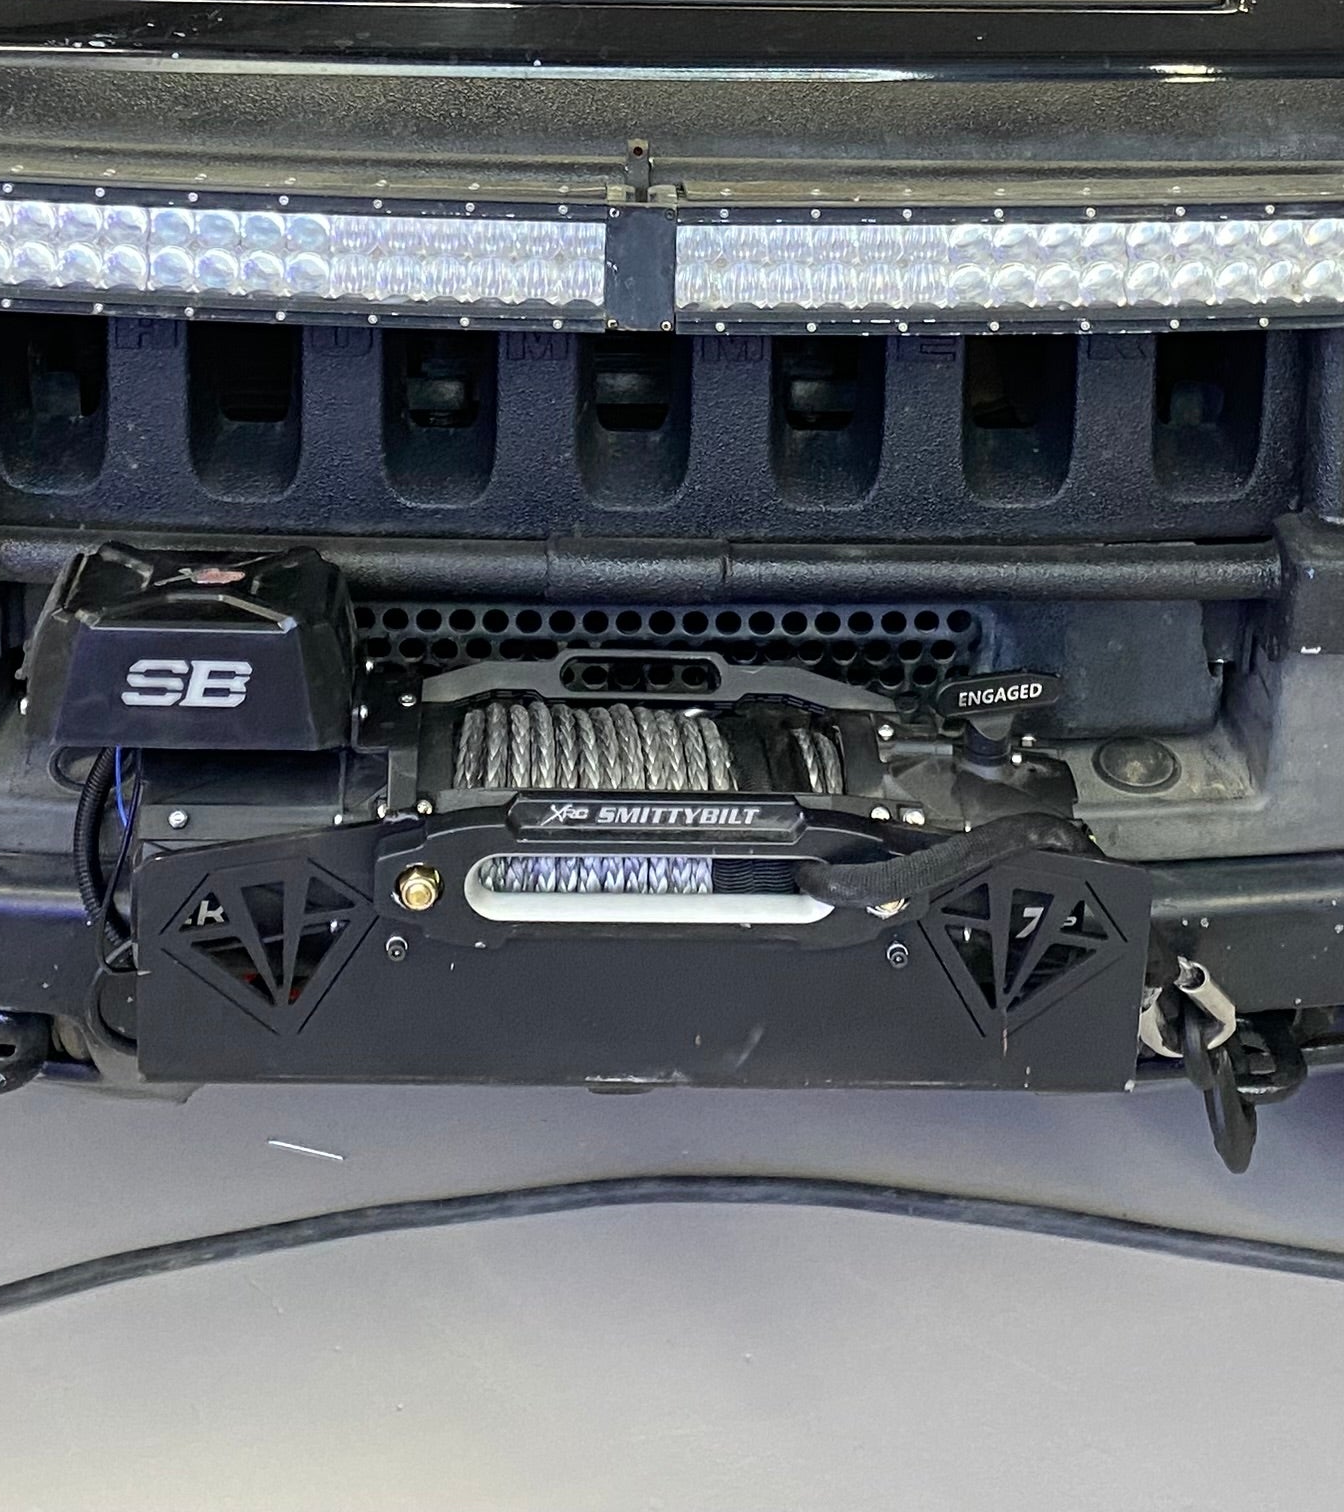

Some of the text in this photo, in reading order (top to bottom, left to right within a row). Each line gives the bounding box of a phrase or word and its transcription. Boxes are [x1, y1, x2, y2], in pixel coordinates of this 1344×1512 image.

[120, 659, 253, 708] SB
[958, 682, 1043, 708] ENGAGED
[597, 806, 760, 825] SMITTYBILT
